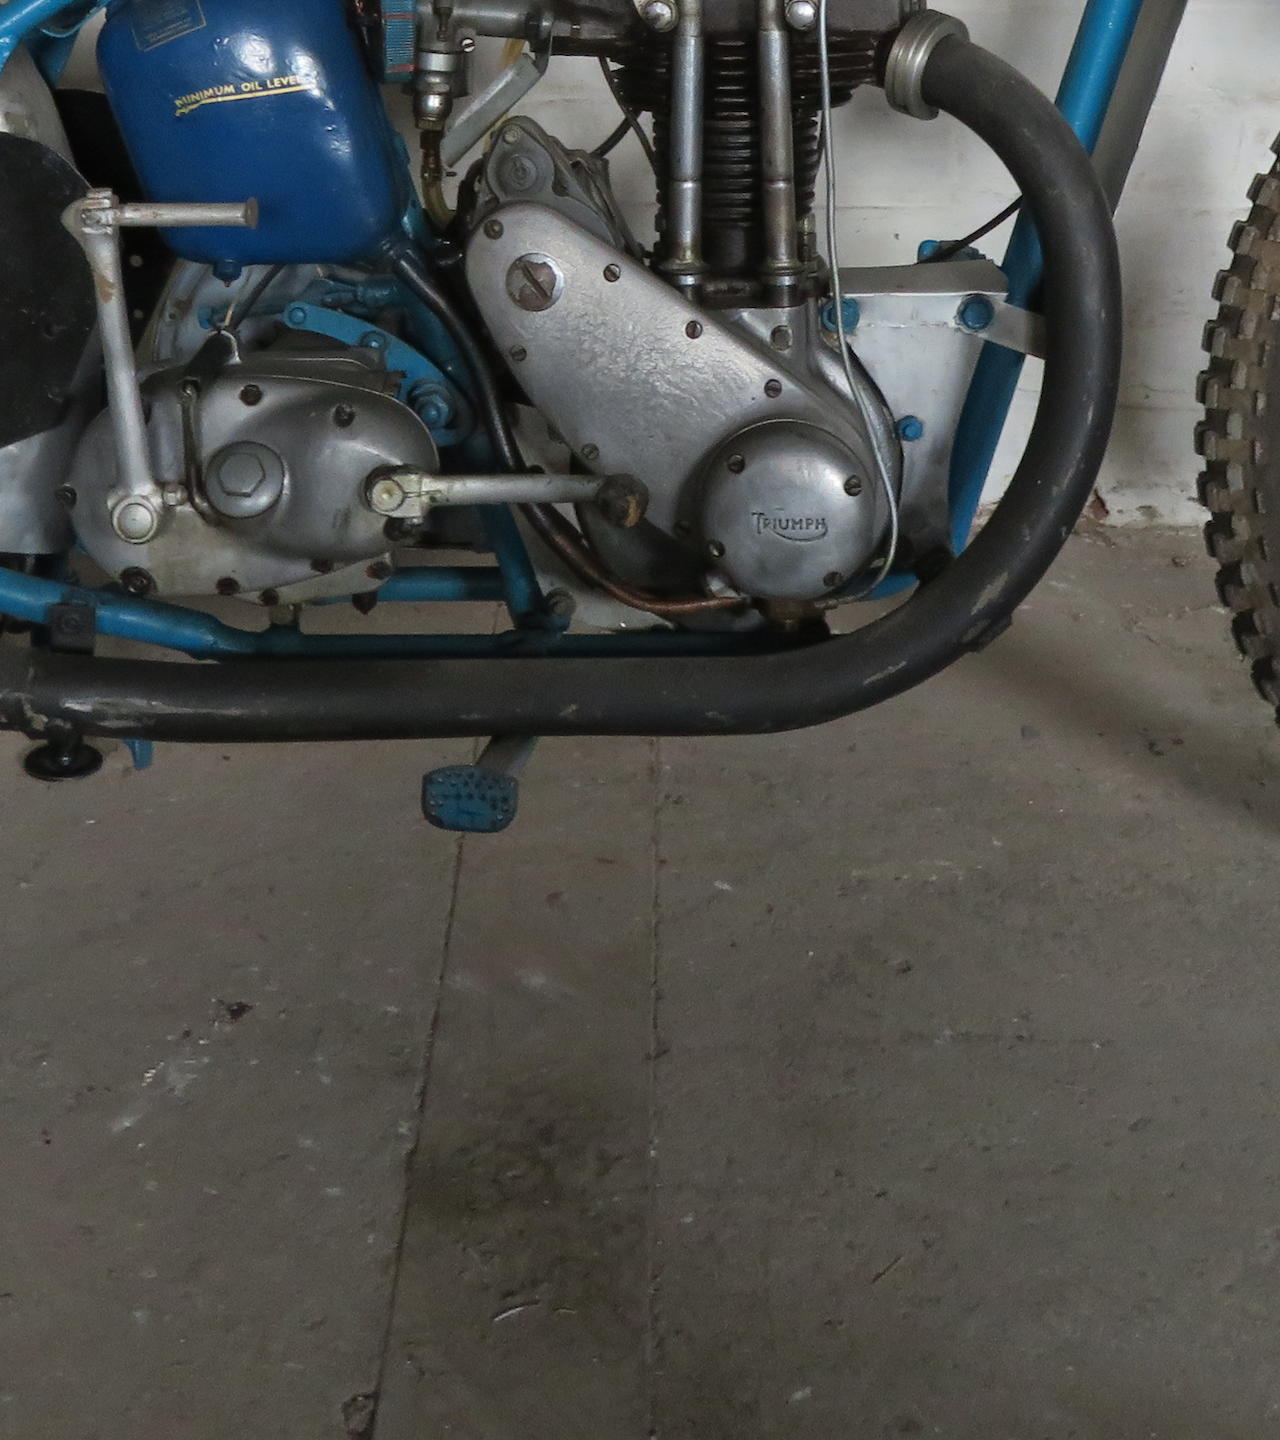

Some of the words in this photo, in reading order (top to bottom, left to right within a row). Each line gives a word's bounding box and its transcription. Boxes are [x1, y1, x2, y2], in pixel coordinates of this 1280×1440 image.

[175, 85, 235, 107] MINIMUM
[241, 81, 263, 92] OIL
[751, 512, 828, 542] TRIUMPH
